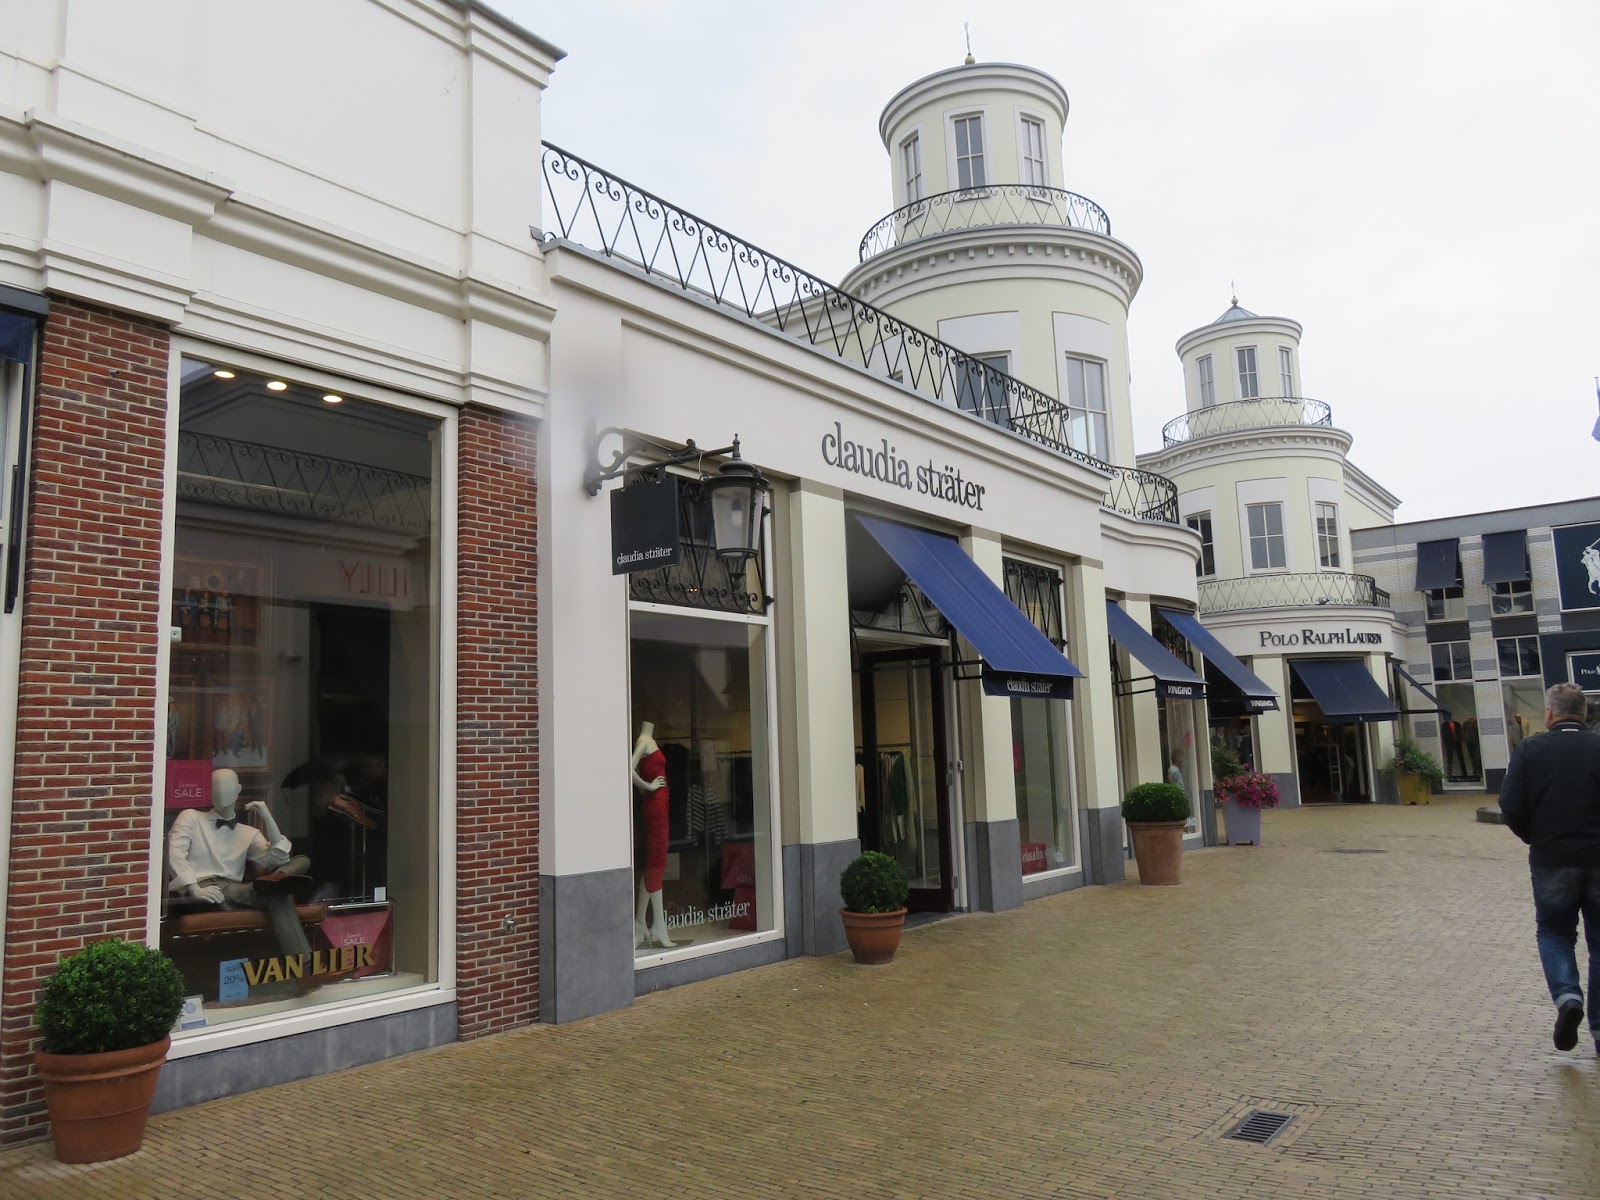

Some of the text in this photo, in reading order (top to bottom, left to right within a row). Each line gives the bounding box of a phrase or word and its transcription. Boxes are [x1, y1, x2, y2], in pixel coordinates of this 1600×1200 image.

[821, 421, 986, 511] claudia sträter
[616, 546, 673, 565] claudia sträter
[1259, 628, 1382, 647] POLO RALPH LAUREN
[1167, 685, 1193, 695] VINGINO
[174, 788, 203, 798] SALE
[662, 900, 751, 930] laudia sträter
[343, 936, 366, 946] SALE
[242, 943, 376, 987] VAN LIER
[224, 974, 245, 985] 20%
